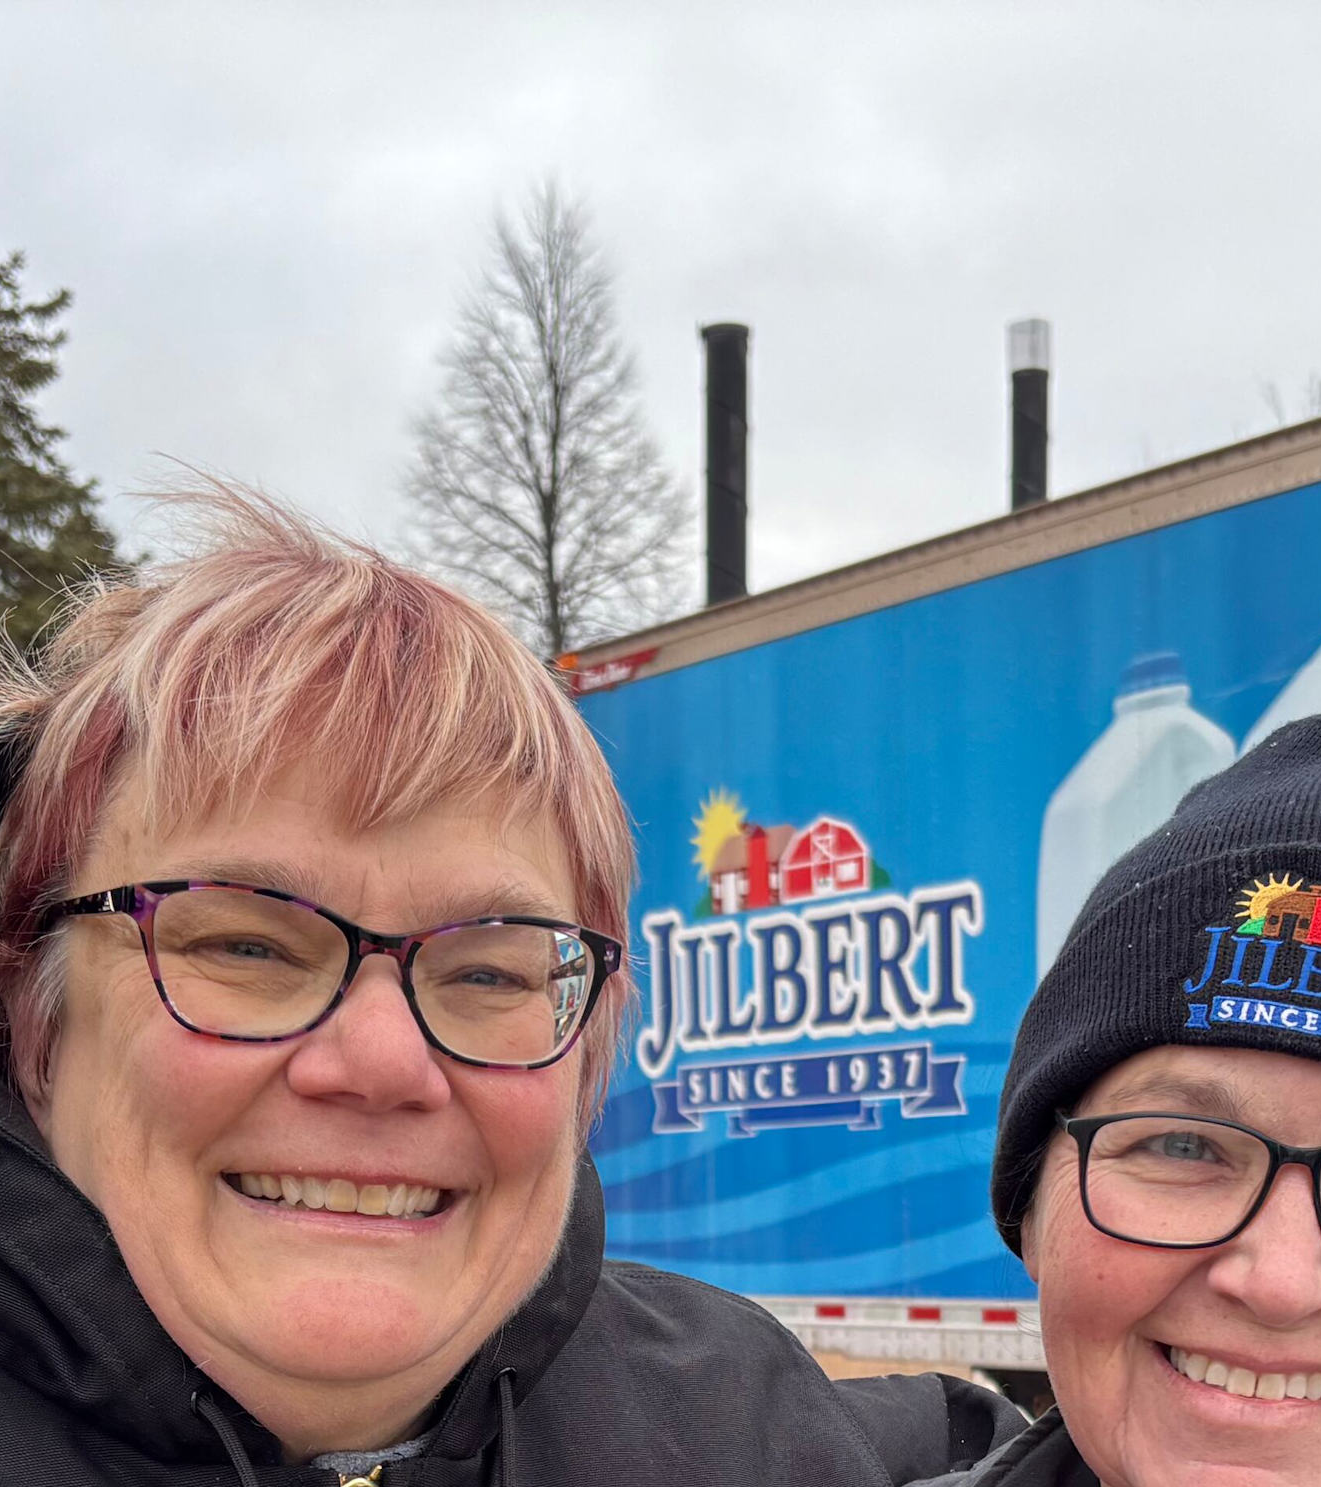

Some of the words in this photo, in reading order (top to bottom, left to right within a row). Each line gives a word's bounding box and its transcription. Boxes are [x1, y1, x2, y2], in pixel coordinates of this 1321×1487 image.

[639, 882, 982, 1076] JILBERT
[1217, 1000, 1320, 1032] SINCE
[687, 1062, 799, 1105] SINCE
[826, 1052, 923, 1096] 1937
